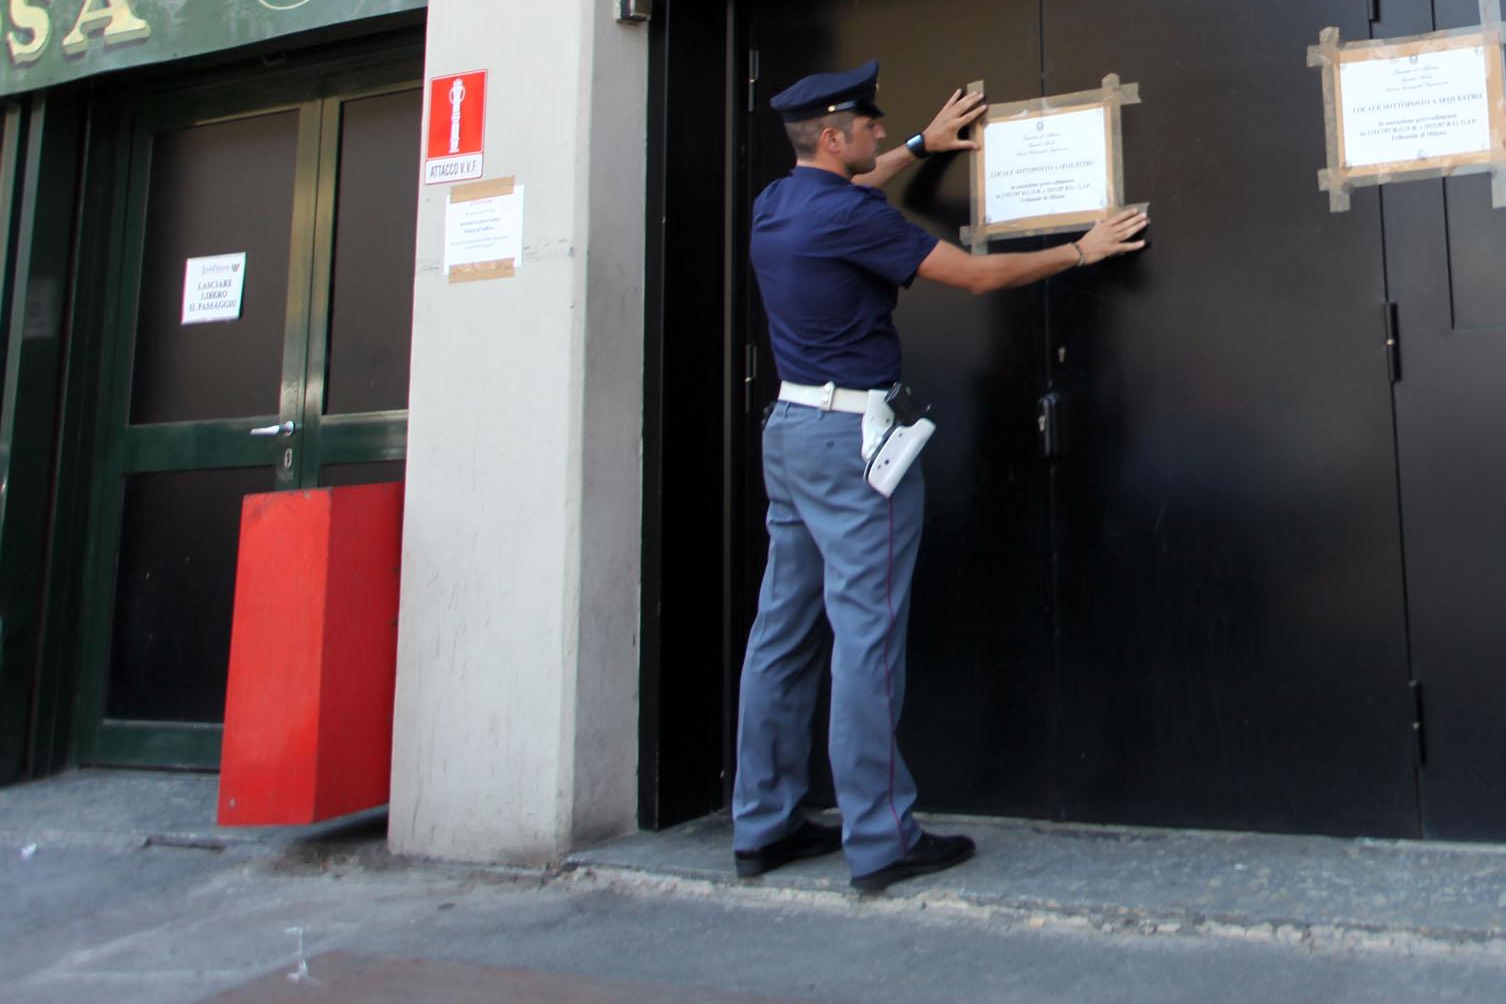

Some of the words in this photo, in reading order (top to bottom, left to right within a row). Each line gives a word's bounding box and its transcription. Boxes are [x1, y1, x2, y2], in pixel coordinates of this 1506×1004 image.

[430, 163, 459, 177] ATTACCO
[198, 279, 232, 290] LASCIARE
[201, 290, 228, 300] LIBERO
[198, 300, 237, 311] PASSAGGIO
